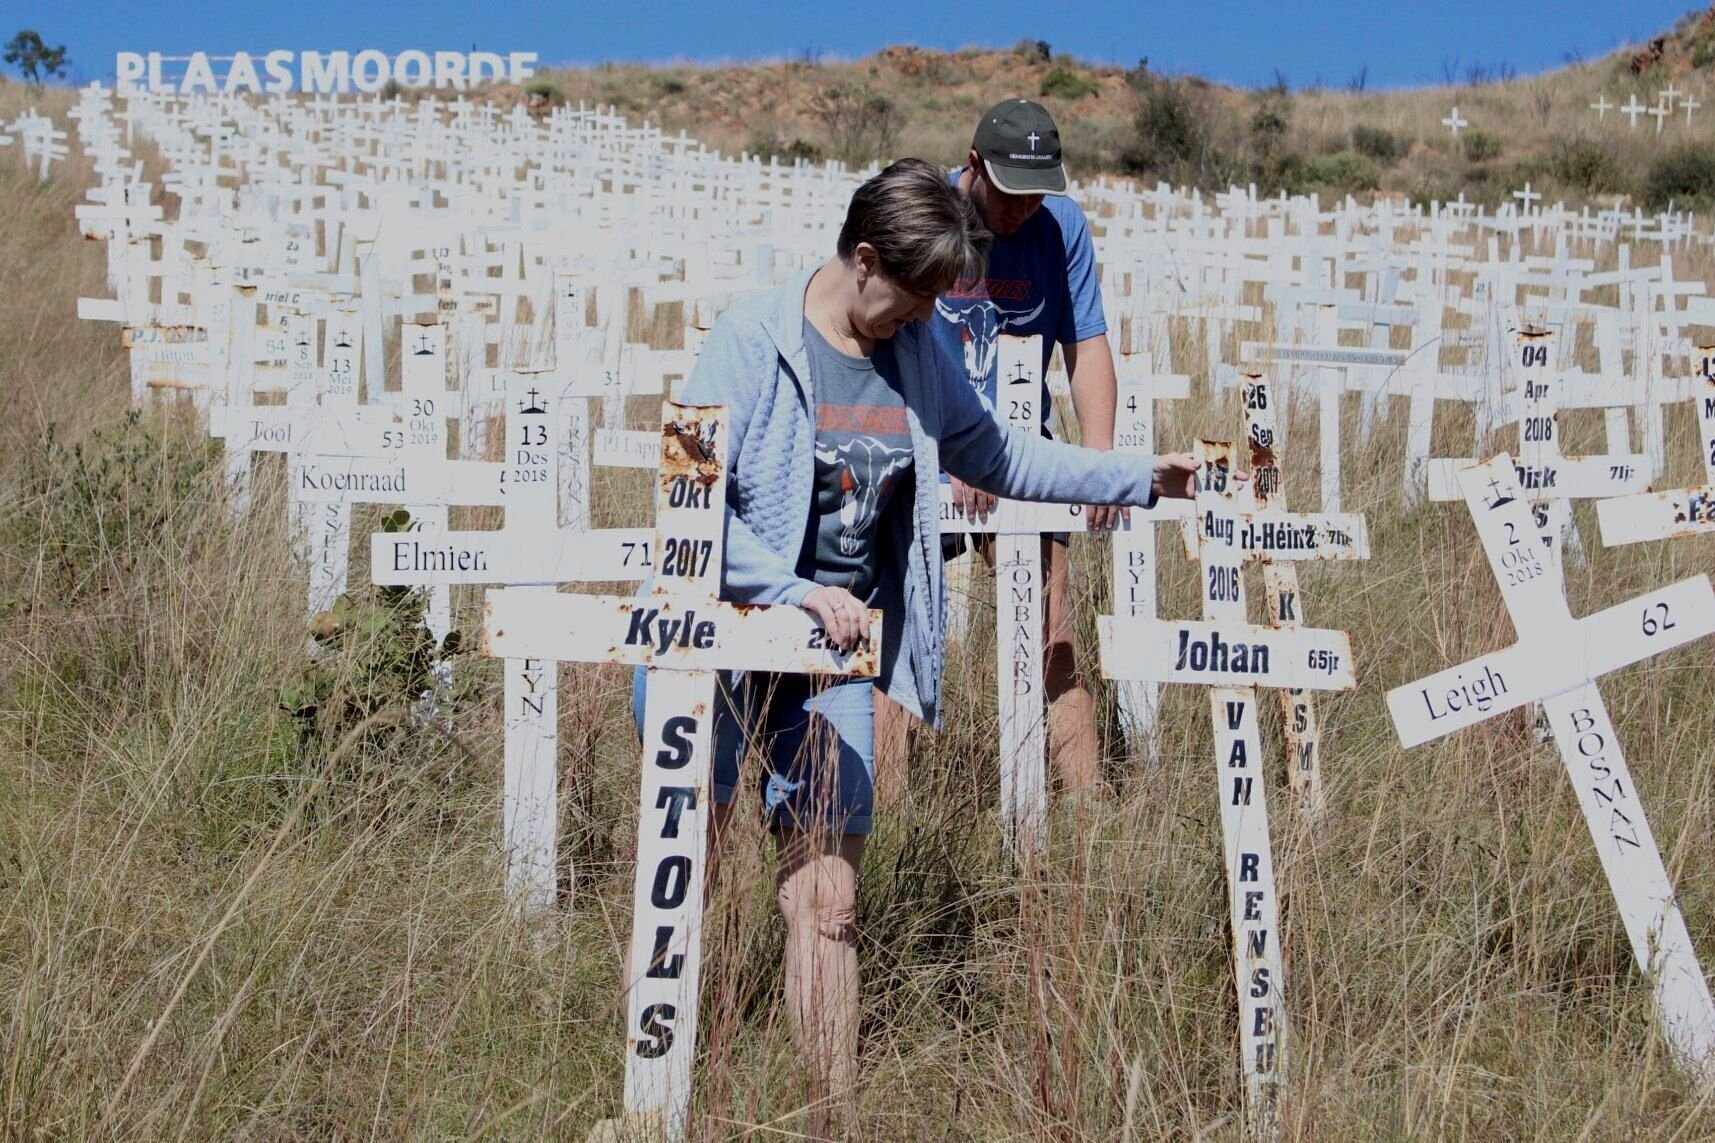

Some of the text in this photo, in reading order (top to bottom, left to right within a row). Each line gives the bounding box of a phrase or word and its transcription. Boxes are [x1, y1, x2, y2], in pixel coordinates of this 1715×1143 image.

[333, 359, 351, 373] 13
[1522, 345, 1547, 367] 04
[1248, 383, 1267, 409] 26
[1524, 380, 1549, 403] Apr
[413, 399, 434, 417] 30
[1009, 401, 1031, 420] 28
[410, 417, 435, 431] Okt
[521, 425, 547, 445] 13
[1525, 417, 1552, 441] 2018
[410, 434, 437, 445] 2019
[1119, 434, 1144, 446] 2018
[517, 449, 547, 465] Des
[301, 464, 405, 492] Koenraad
[514, 469, 547, 482] 2018
[669, 478, 712, 509] Okt
[1205, 511, 1234, 547] Aug
[1504, 522, 1519, 545] 2
[622, 542, 652, 566] 71
[662, 538, 713, 577] 2017
[1502, 548, 1535, 569] Okt
[1209, 565, 1239, 601] 2016
[1507, 562, 1543, 586] 2018
[1011, 550, 1032, 696] LOMBAARD
[1642, 602, 1676, 637] 62
[625, 607, 717, 657] Kyle
[1175, 630, 1339, 675] Johan 65jr
[1421, 665, 1509, 721] Leigh
[1226, 701, 1253, 806] VAN
[1570, 708, 1640, 855] BOSMAN
[636, 716, 698, 1059] STOLS
